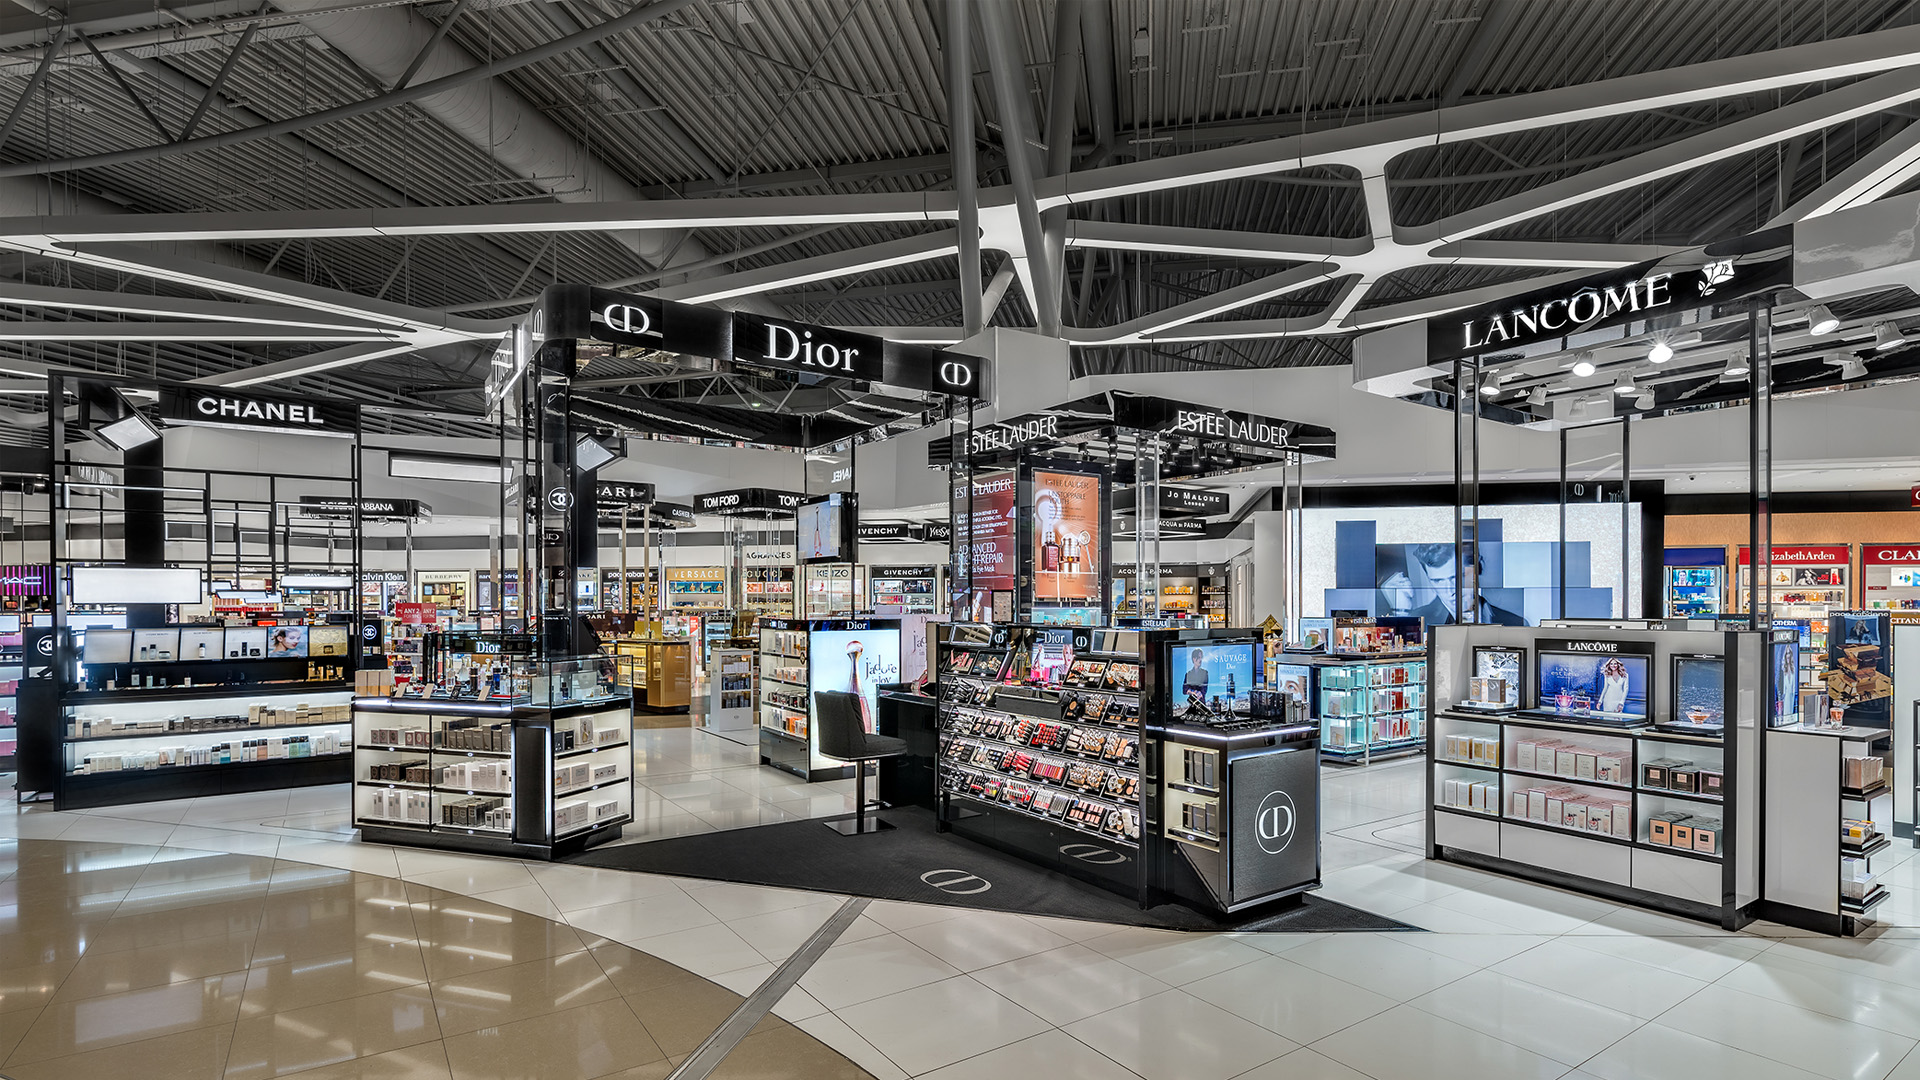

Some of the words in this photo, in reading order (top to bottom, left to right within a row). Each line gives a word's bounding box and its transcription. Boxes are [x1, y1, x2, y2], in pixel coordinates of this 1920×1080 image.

[1462, 273, 1672, 350] LANCÔME
[762, 323, 859, 372] Dior
[197, 397, 324, 424] CHANEL
[1002, 415, 1058, 446] LAUDER
[1229, 421, 1288, 446] LAUDER
[979, 478, 1011, 495] LAUDER
[357, 502, 394, 511] ABBANA
[702, 496, 718, 508] TOM
[719, 494, 740, 506] FORD
[1158, 520, 1178, 528] ACQUA
[858, 527, 899, 535] IVENCHY
[958, 541, 997, 554] ADANCED
[981, 552, 1004, 564] REPAIR
[1878, 549, 1920, 560] CLA
[357, 572, 383, 581] alvin
[384, 572, 404, 581] Klein
[674, 570, 720, 578] VERSACE
[846, 621, 868, 630] Dior
[1044, 632, 1065, 644] Dior
[475, 641, 501, 653] Dior
[1567, 642, 1618, 652] LANCÔME
[1214, 654, 1247, 663] SAUVAGE
